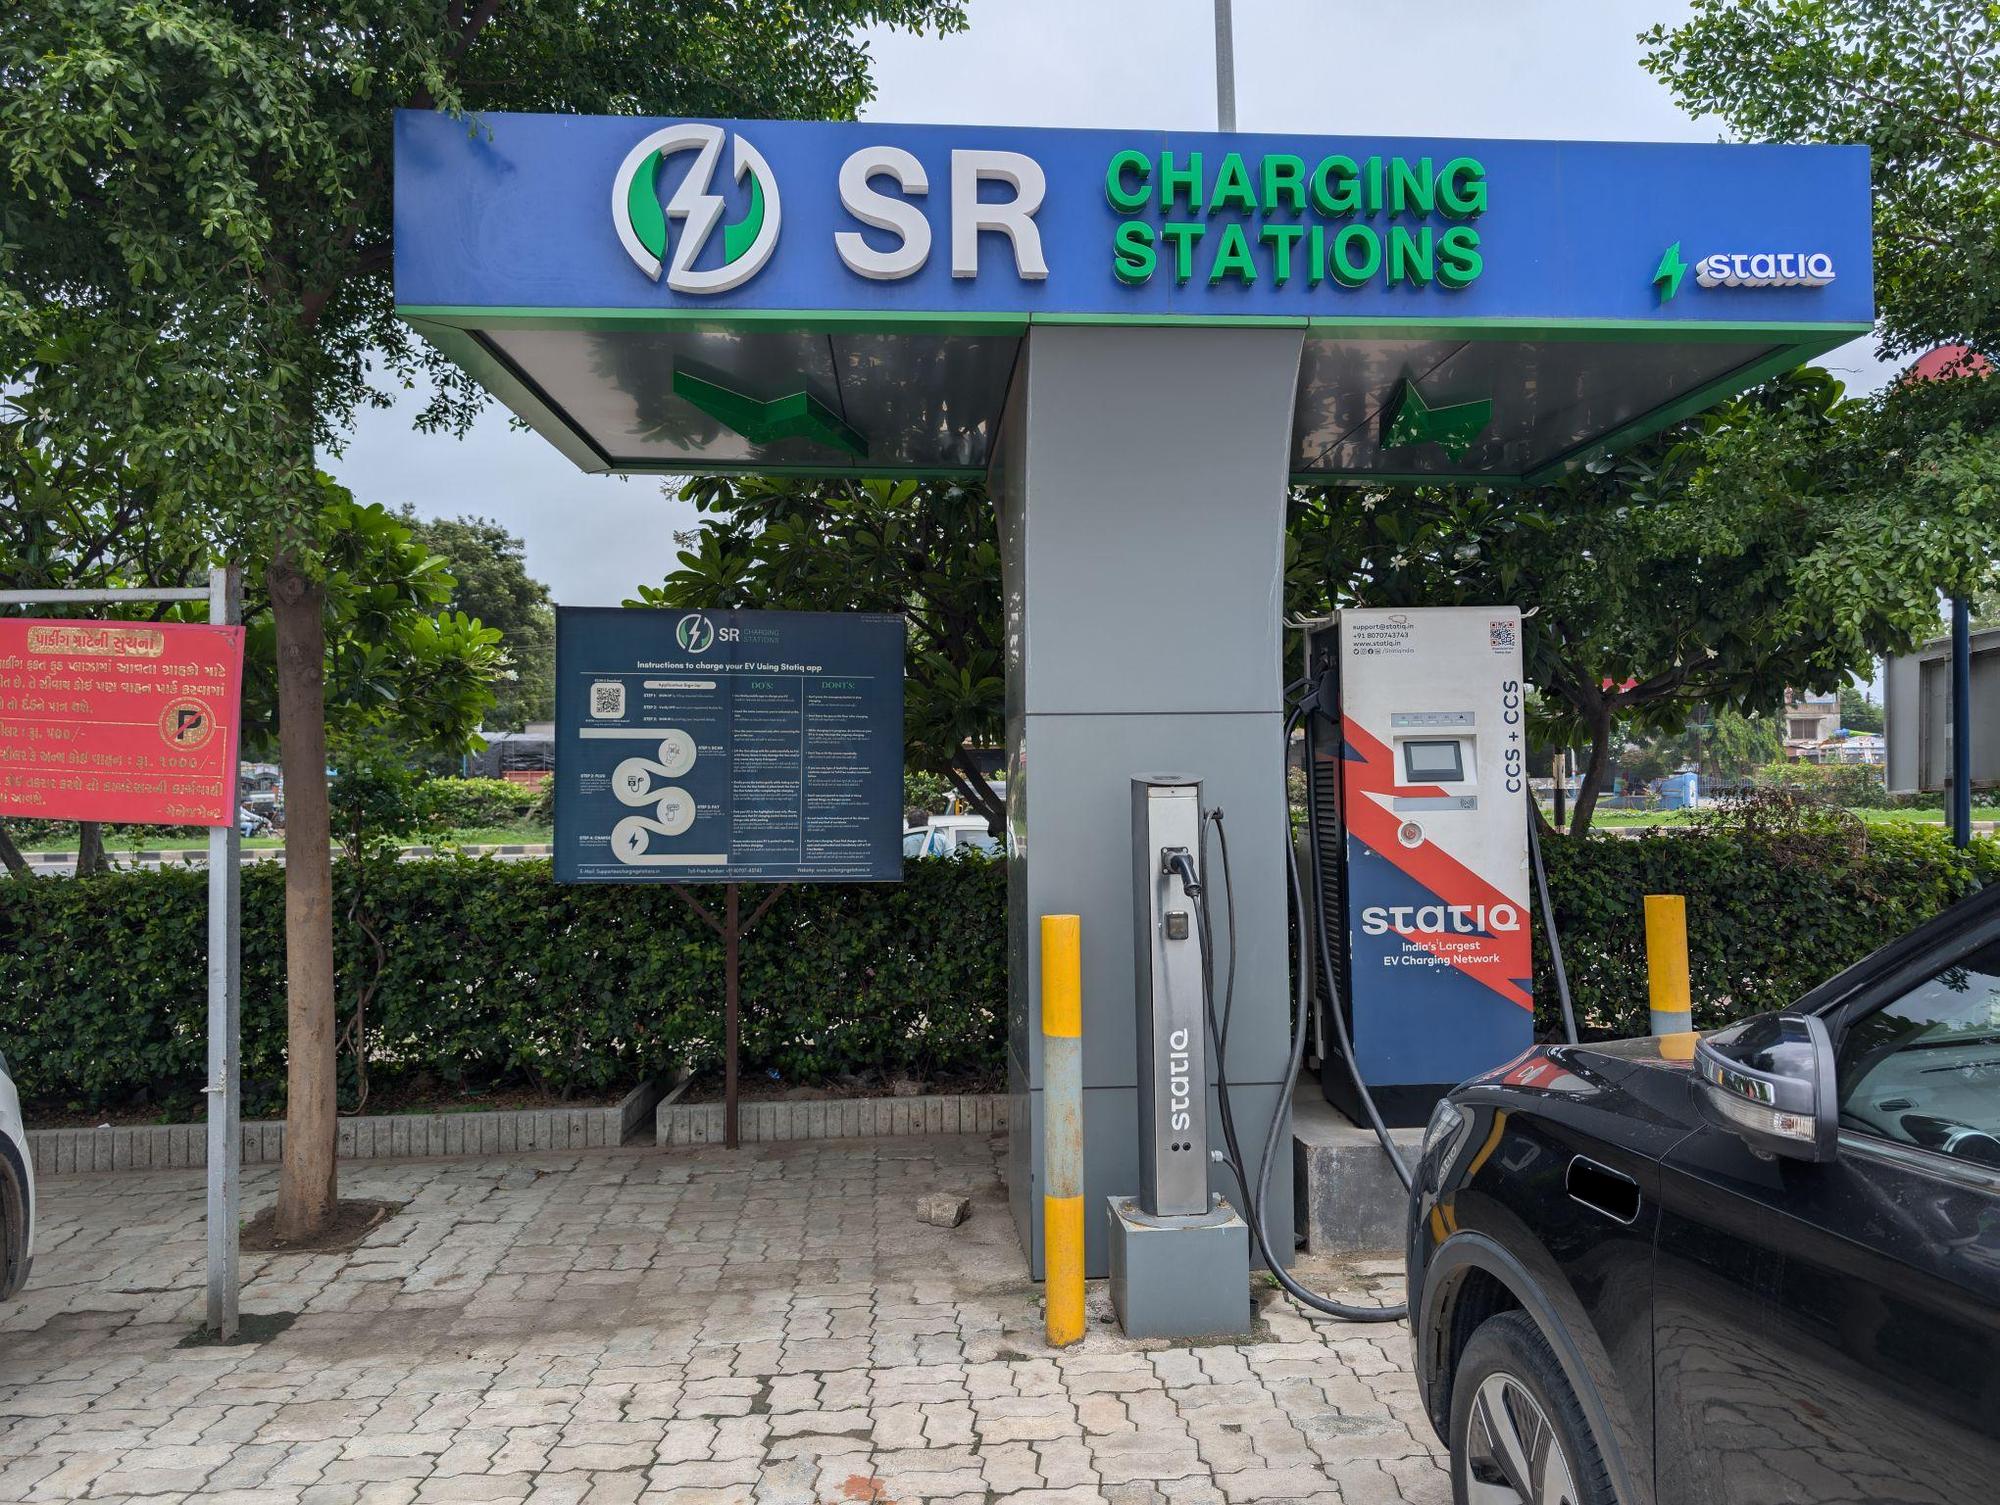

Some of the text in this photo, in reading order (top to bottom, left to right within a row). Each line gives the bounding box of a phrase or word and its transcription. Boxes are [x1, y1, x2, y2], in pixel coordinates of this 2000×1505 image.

[1106, 149, 1487, 219] CHARGING
[834, 145, 1049, 281] SR
[1112, 221, 1483, 289] STATIONS
[743, 628, 780, 636] CHARGING
[1353, 623, 1414, 632] support@statiq.in
[718, 627, 740, 642] SR
[743, 636, 780, 644] STATIONS
[204, 663, 226, 677] માટે
[637, 660, 684, 669] Instructions
[685, 661, 694, 669] to
[695, 661, 724, 672] charge
[725, 663, 743, 672] your
[756, 663, 778, 672] Using
[780, 663, 804, 673] Statiq
[1503, 680, 1521, 793] CCS + CCS
[1402, 941, 1481, 953] India's Largest
[1384, 954, 1499, 967] EV Charging Network
